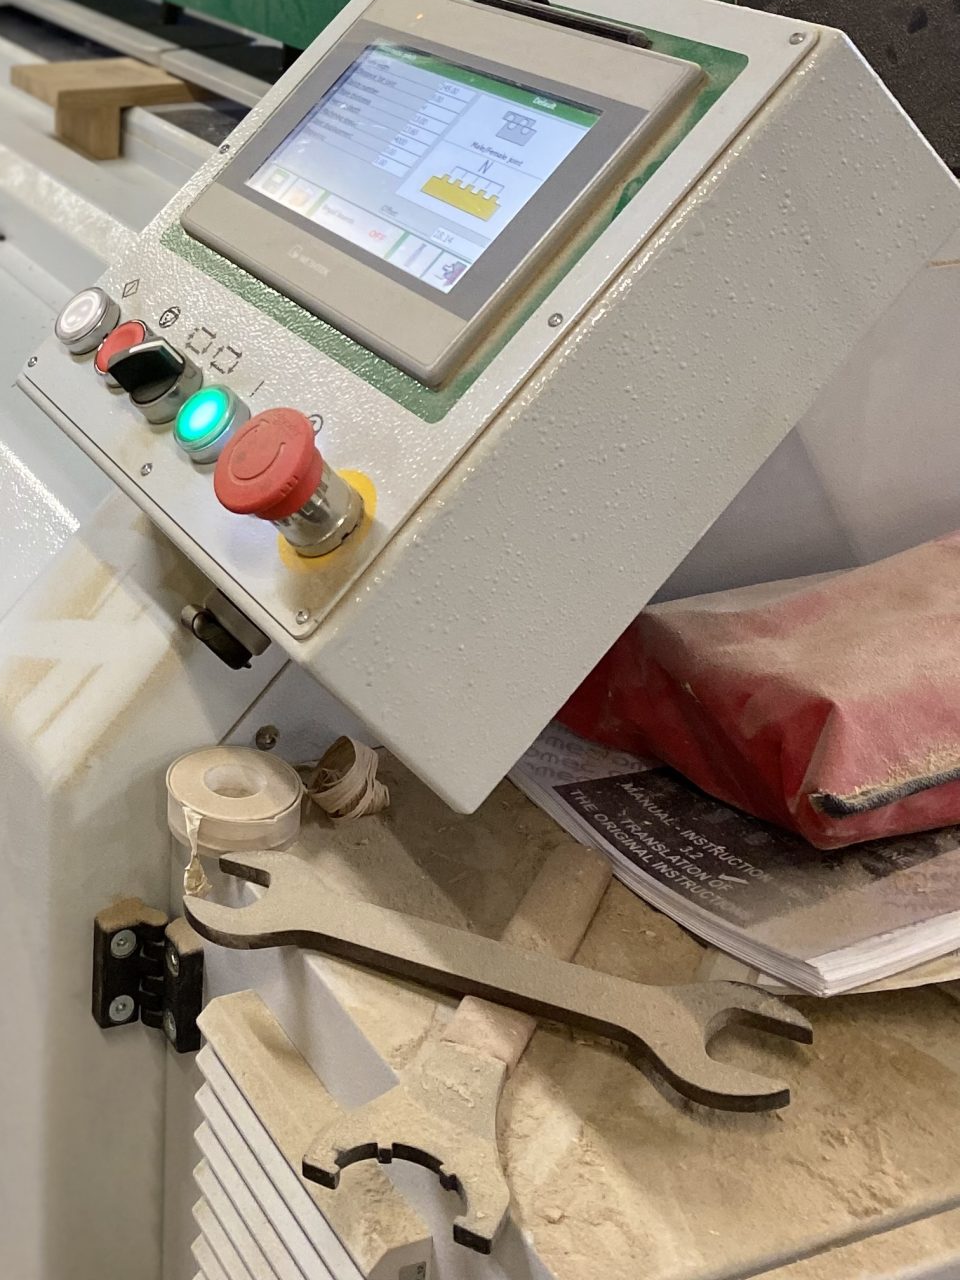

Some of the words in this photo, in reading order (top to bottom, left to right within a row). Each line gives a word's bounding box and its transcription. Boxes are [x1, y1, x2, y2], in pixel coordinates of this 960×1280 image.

[570, 788, 599, 812] THE
[593, 812, 654, 863] ORIGINAL
[620, 782, 675, 826] MANUAL
[679, 828, 775, 883] INSTRUCTION
[621, 818, 712, 882] TRANSLATION
[708, 878, 733, 892] OF
[679, 845, 704, 861] 3.2
